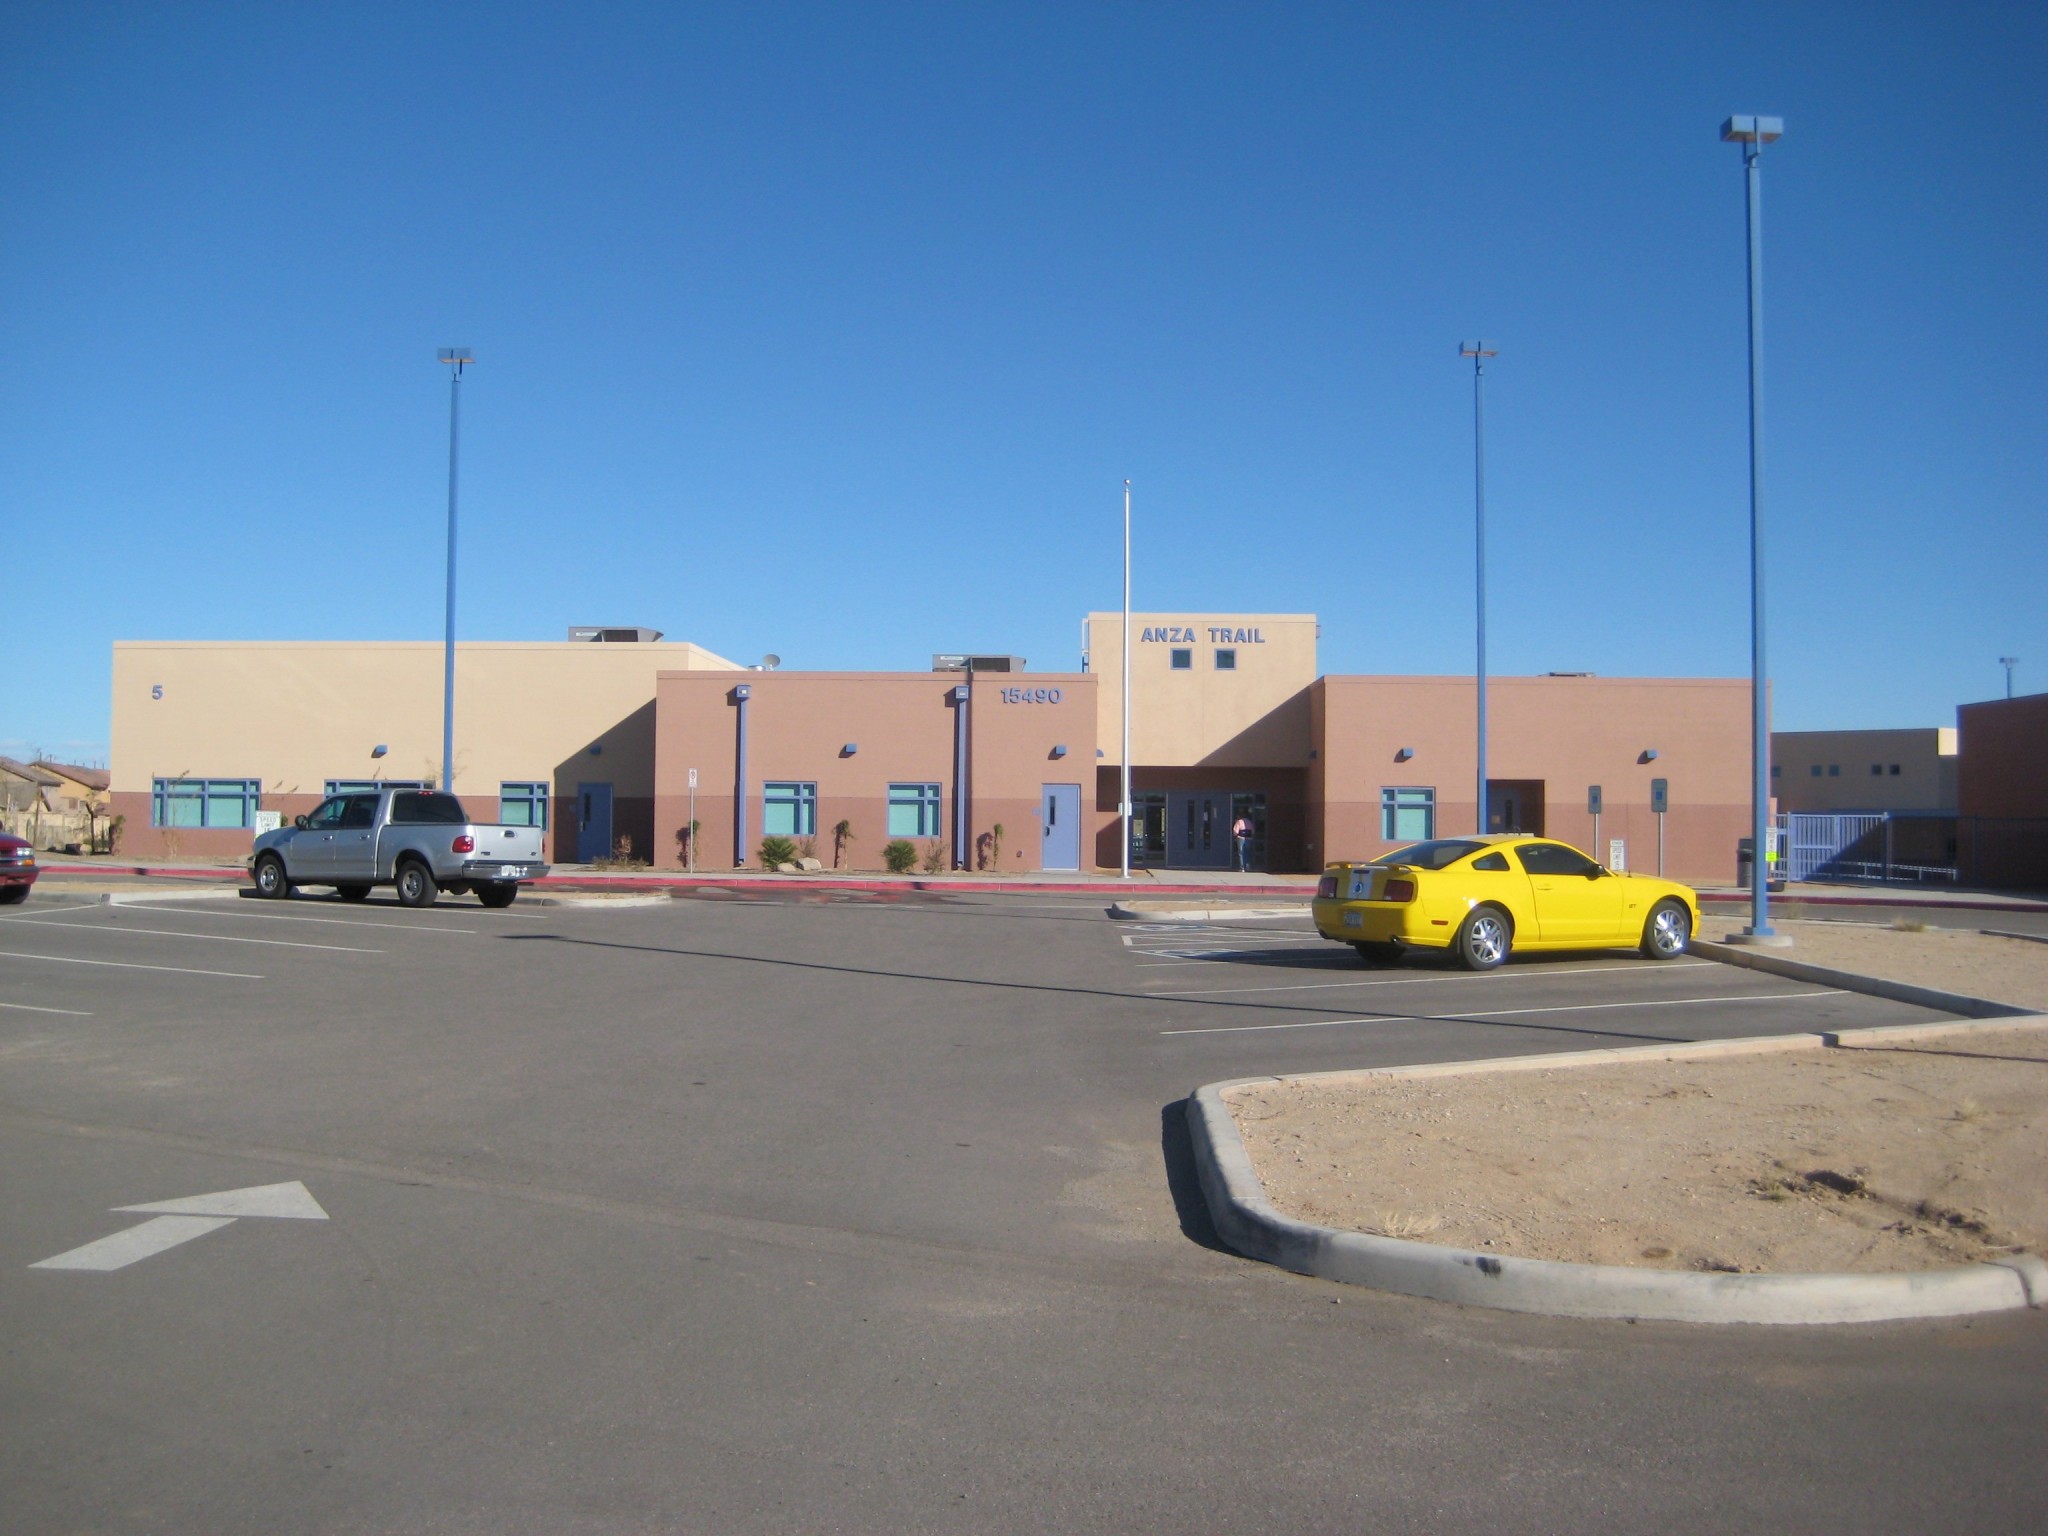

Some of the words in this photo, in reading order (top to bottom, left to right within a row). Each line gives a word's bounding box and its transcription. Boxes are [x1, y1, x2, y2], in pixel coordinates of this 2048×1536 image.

[1141, 627, 1196, 642] ANZA
[1208, 627, 1265, 643] TRAIL
[152, 685, 163, 700] 5
[1001, 687, 1063, 704] 15490
